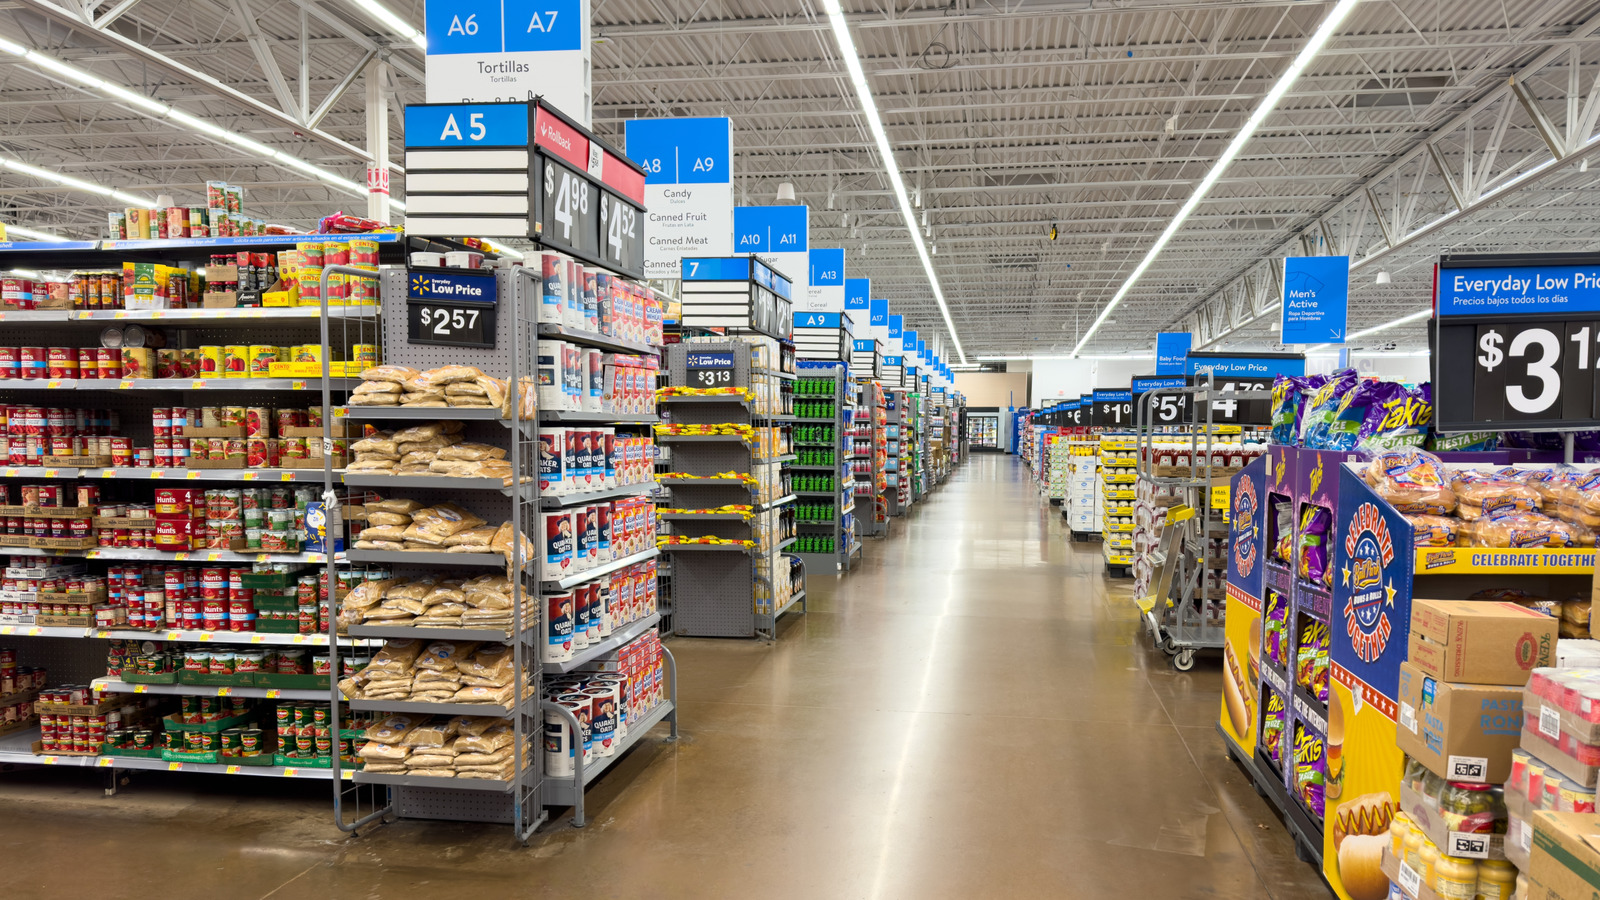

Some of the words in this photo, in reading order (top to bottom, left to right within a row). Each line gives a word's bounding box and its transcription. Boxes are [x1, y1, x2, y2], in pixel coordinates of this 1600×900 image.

[448, 14, 479, 36] A6
[526, 10, 559, 34] A7
[478, 60, 530, 74] Tortillas
[548, 126, 572, 151] Rollback
[642, 158, 662, 173] A8
[693, 157, 714, 172] A9
[664, 189, 692, 200] Candy
[650, 213, 683, 222] Canned
[686, 212, 707, 221] Fruit
[650, 237, 683, 245] Canned
[685, 236, 708, 245] Meat
[740, 234, 760, 245] A10
[780, 234, 796, 244] A11
[643, 260, 677, 268] Canned
[760, 256, 778, 264] Sugar
[689, 262, 699, 277] 7
[821, 271, 836, 279] A13
[432, 284, 454, 294] Low
[456, 285, 482, 296] Price
[1289, 290, 1316, 298] Men's
[1453, 275, 1530, 299] Everyday
[1536, 275, 1568, 290] Low
[1289, 300, 1318, 308] Active
[1453, 296, 1484, 305] Precios
[1487, 296, 1509, 307] bajos
[1511, 295, 1535, 304] todos
[1537, 294, 1549, 303] los
[1194, 363, 1229, 372] Everyday
[1377, 397, 1432, 432] Takis
[1370, 435, 1404, 447] FIESTA
[1436, 435, 1470, 450] FIESTA
[1234, 474, 1258, 515] CELEBRATE
[1345, 502, 1394, 569] CELEBRATE
[1234, 537, 1256, 578] TOGETHER
[1472, 554, 1539, 566] CELEBRATE
[1353, 561, 1366, 586] Ball
[1366, 556, 1381, 581] Park
[1354, 595, 1365, 604] BUNS
[1370, 590, 1382, 601] ROLLS
[1344, 596, 1392, 663] TOGETHER
[1482, 699, 1523, 712] PASTA
[1425, 712, 1444, 733] PASTA
